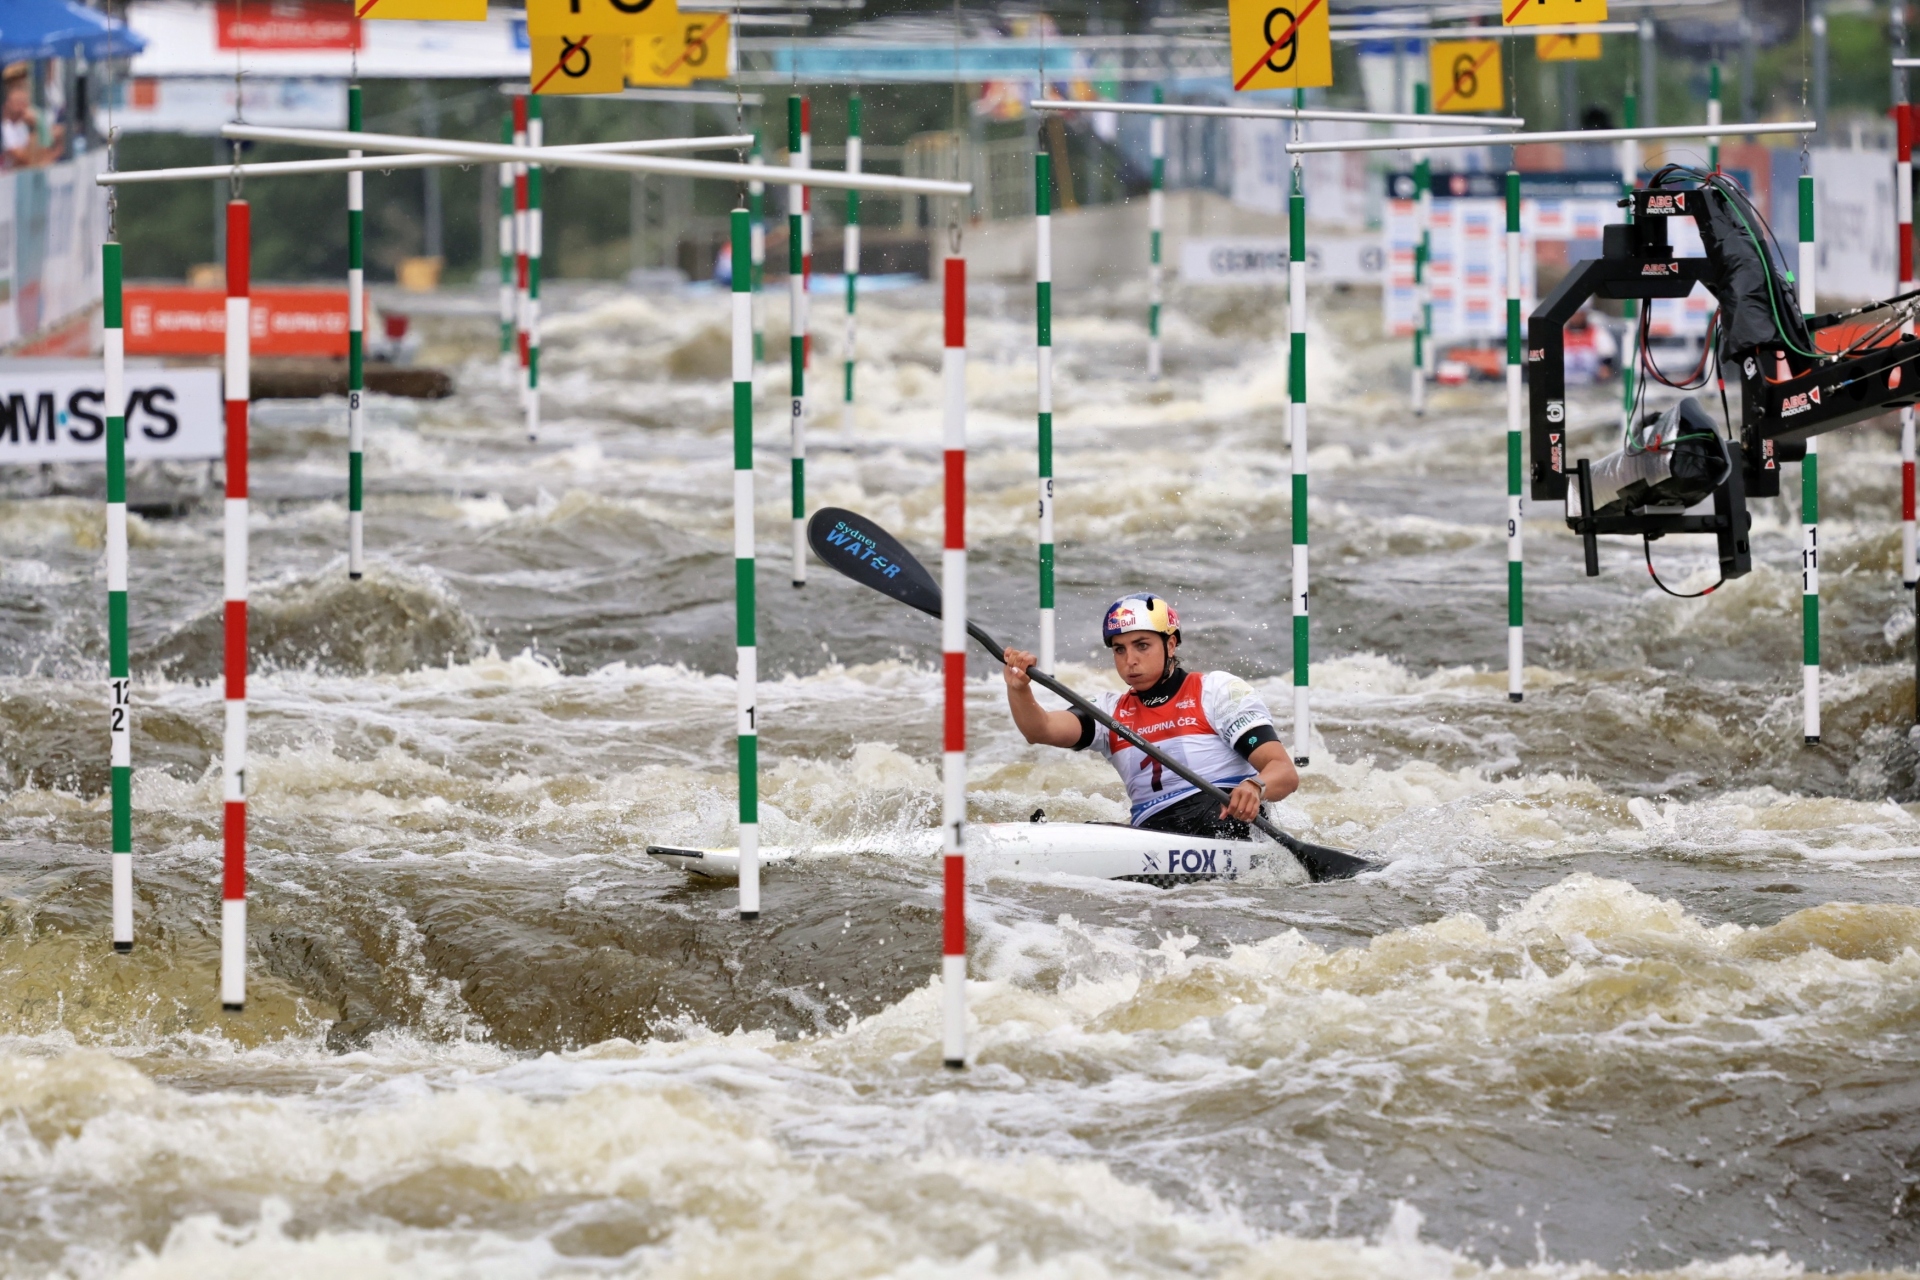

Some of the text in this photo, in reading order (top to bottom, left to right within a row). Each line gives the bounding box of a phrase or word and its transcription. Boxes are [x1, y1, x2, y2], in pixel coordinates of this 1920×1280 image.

[684, 24, 708, 66] 5
[1264, 7, 1297, 73] 9
[1453, 53, 1478, 98] 6
[1648, 195, 1673, 208] ABC
[1642, 263, 1667, 272] ABC
[351, 393, 360, 410] 8
[792, 399, 802, 417] 8
[1781, 403, 1812, 418] PRODUCTS
[1782, 392, 1808, 411] ABC
[1766, 439, 1774, 456] BC
[1551, 446, 1559, 472] ABC
[835, 521, 877, 549] Sydney
[1508, 519, 1516, 537] 9
[826, 529, 901, 579] WATER
[1300, 591, 1308, 611] 1
[1108, 617, 1136, 630] Red Bull
[746, 705, 755, 730] 1
[1137, 716, 1198, 736] SKUPINA ČEZ
[1168, 849, 1216, 873] FOX
